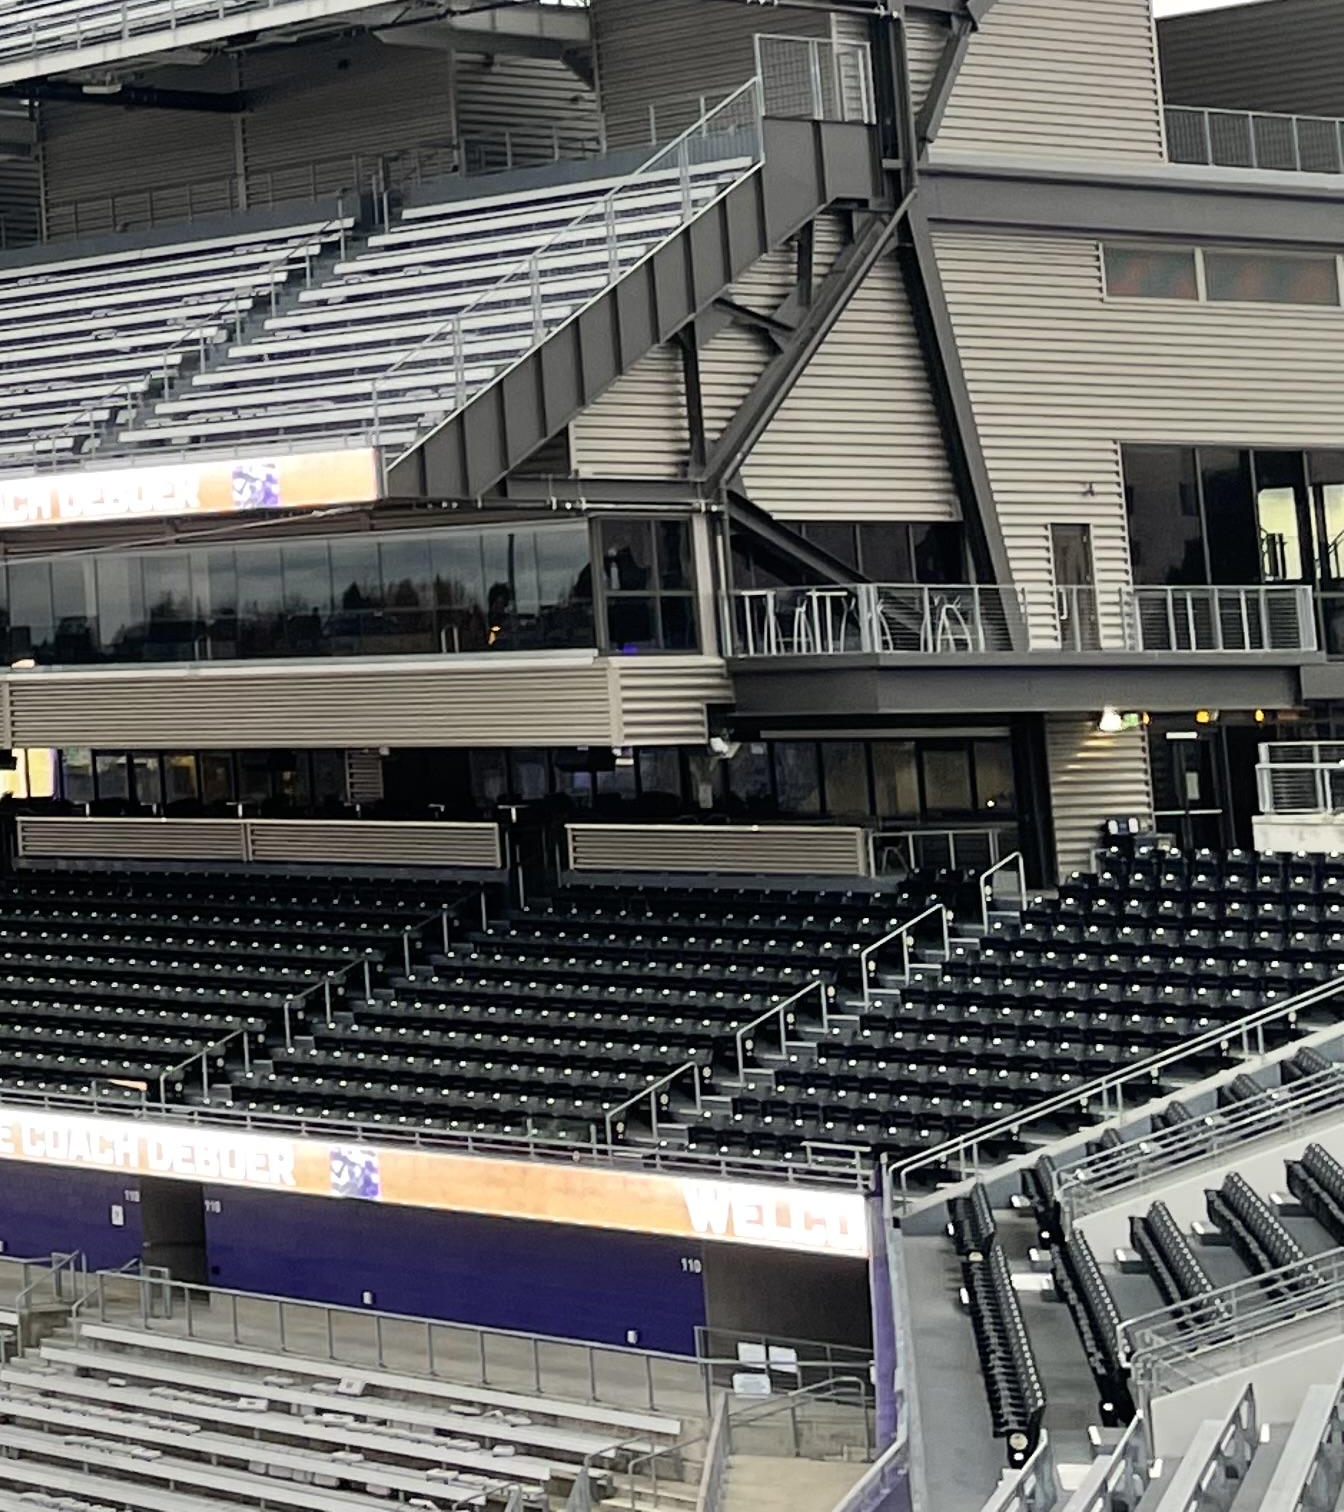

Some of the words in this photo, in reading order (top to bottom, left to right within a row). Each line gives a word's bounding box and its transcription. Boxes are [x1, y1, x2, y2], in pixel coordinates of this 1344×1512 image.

[60, 474, 199, 520] DEBOER
[21, 1116, 135, 1171] COACH
[144, 1131, 296, 1187] DEBOER
